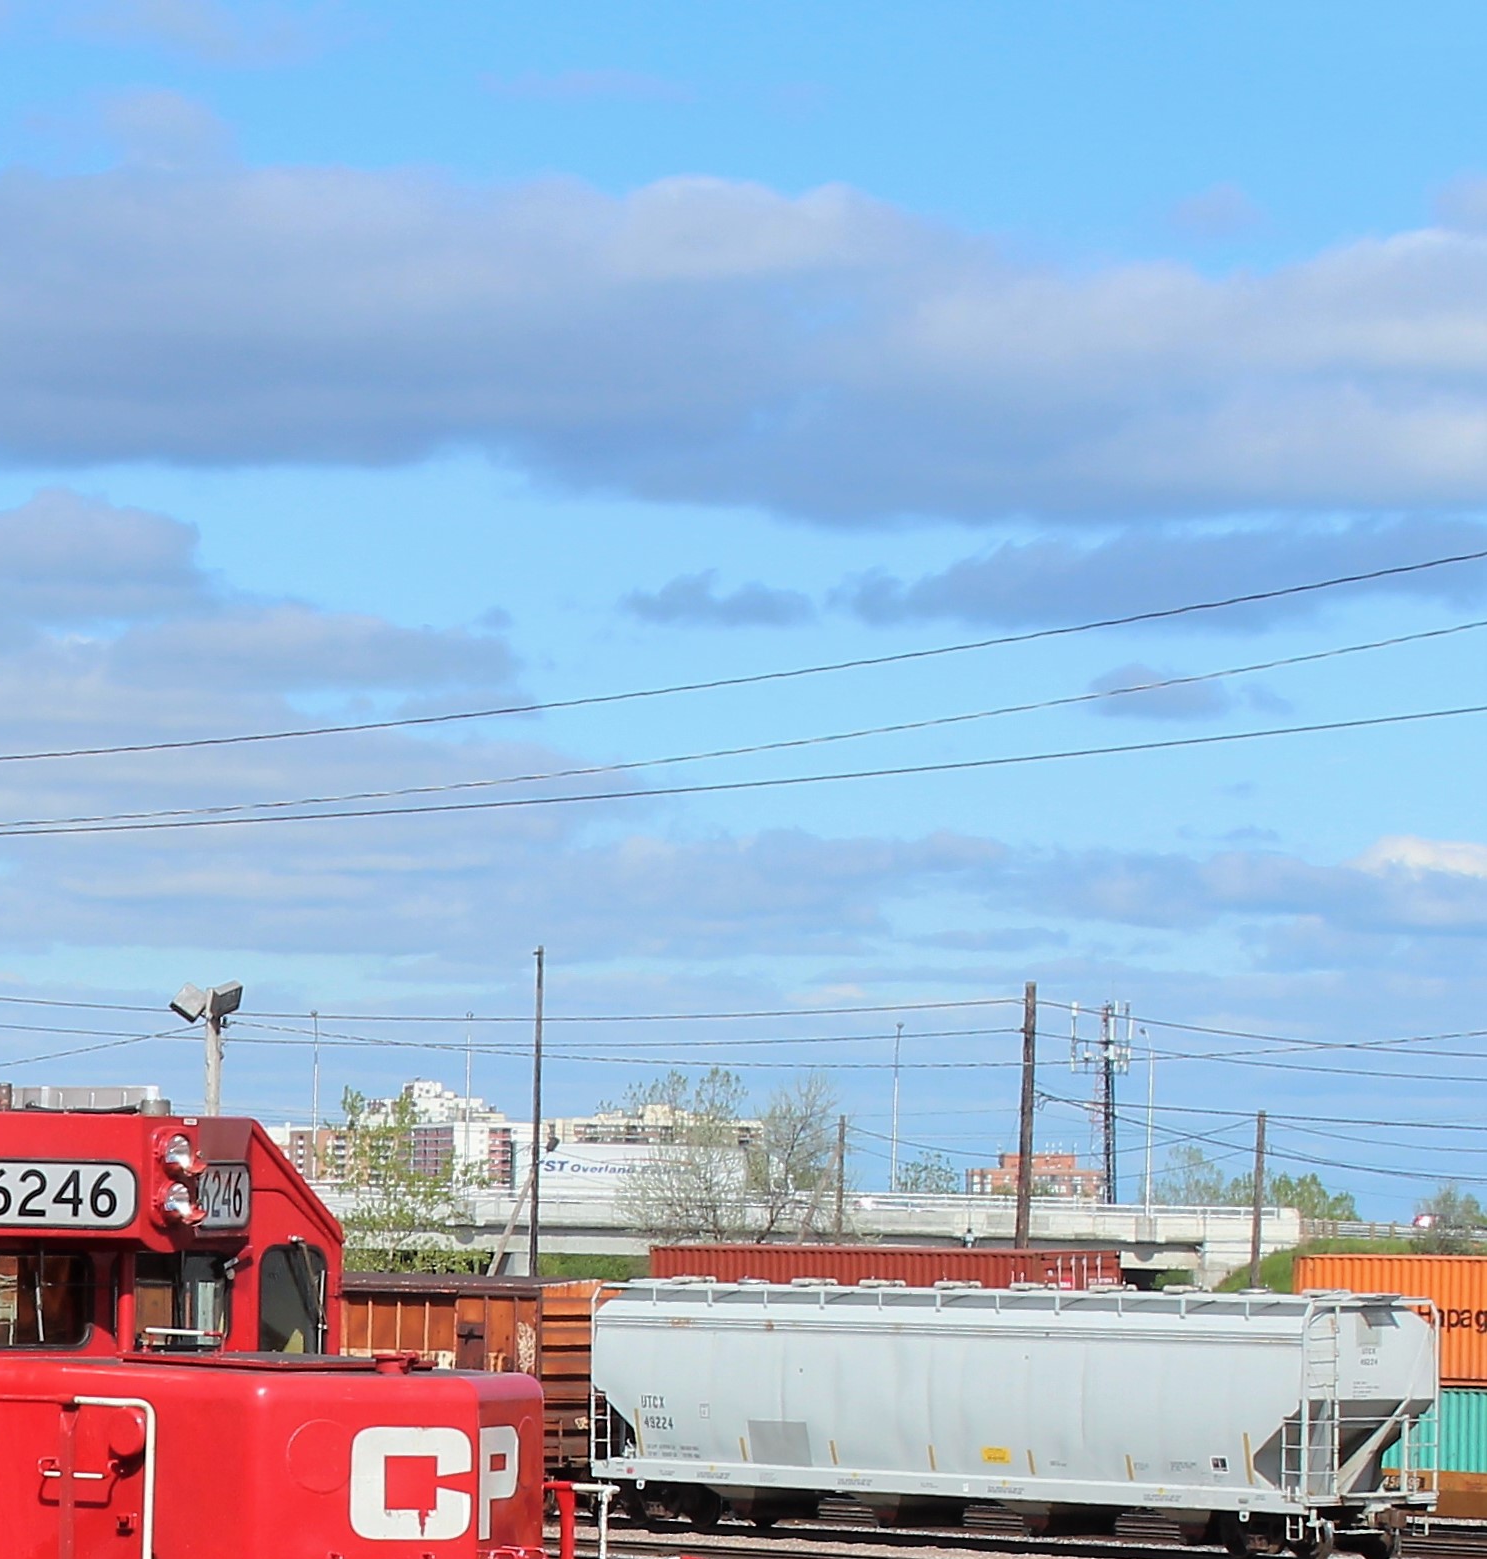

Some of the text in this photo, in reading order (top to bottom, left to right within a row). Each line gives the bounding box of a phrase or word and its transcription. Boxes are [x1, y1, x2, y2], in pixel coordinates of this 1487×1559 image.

[538, 1159, 569, 1172] ST
[199, 1170, 242, 1218] 6246
[641, 1395, 664, 1408] UTCX
[644, 1416, 673, 1429] 49224
[350, 1426, 519, 1540] CP
